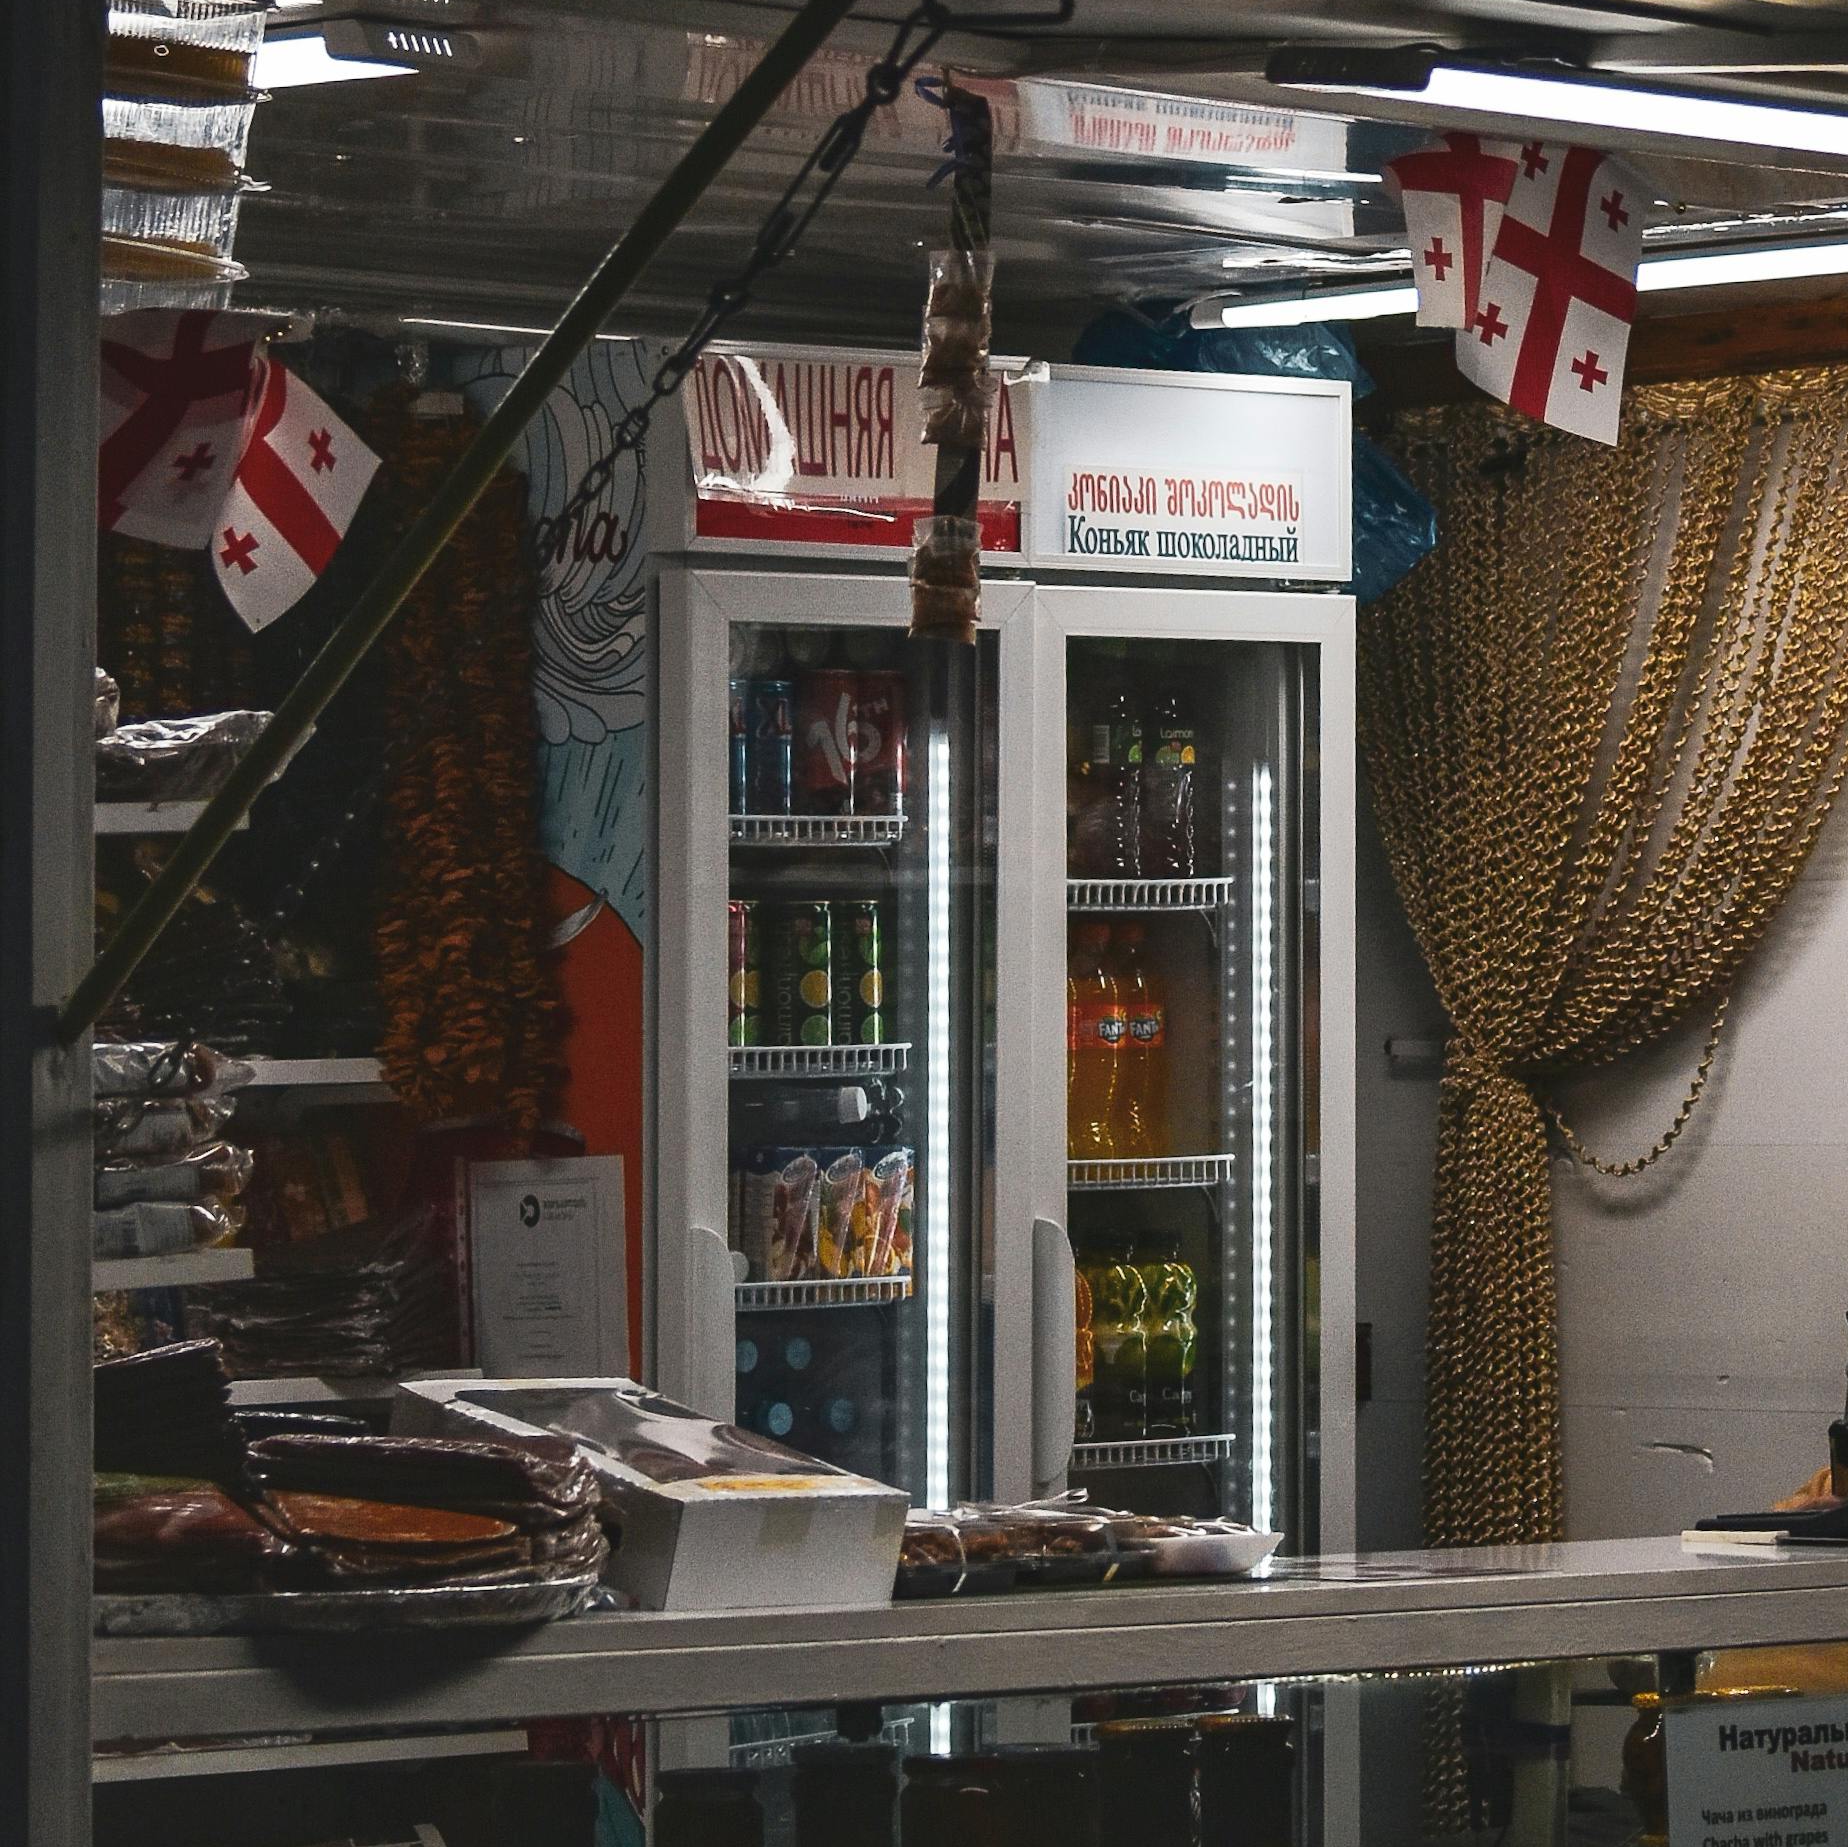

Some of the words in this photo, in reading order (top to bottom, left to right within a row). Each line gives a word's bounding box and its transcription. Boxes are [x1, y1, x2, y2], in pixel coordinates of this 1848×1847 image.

[1068, 472, 1157, 515] კონიაკი
[1165, 478, 1300, 522] შოკოლადის
[1067, 515, 1150, 556] Коньяк
[1156, 526, 1299, 563] шоколадный
[1702, 1808, 1734, 1826] Чача
[1737, 1808, 1753, 1823] из
[1757, 1801, 1828, 1824] винограда
